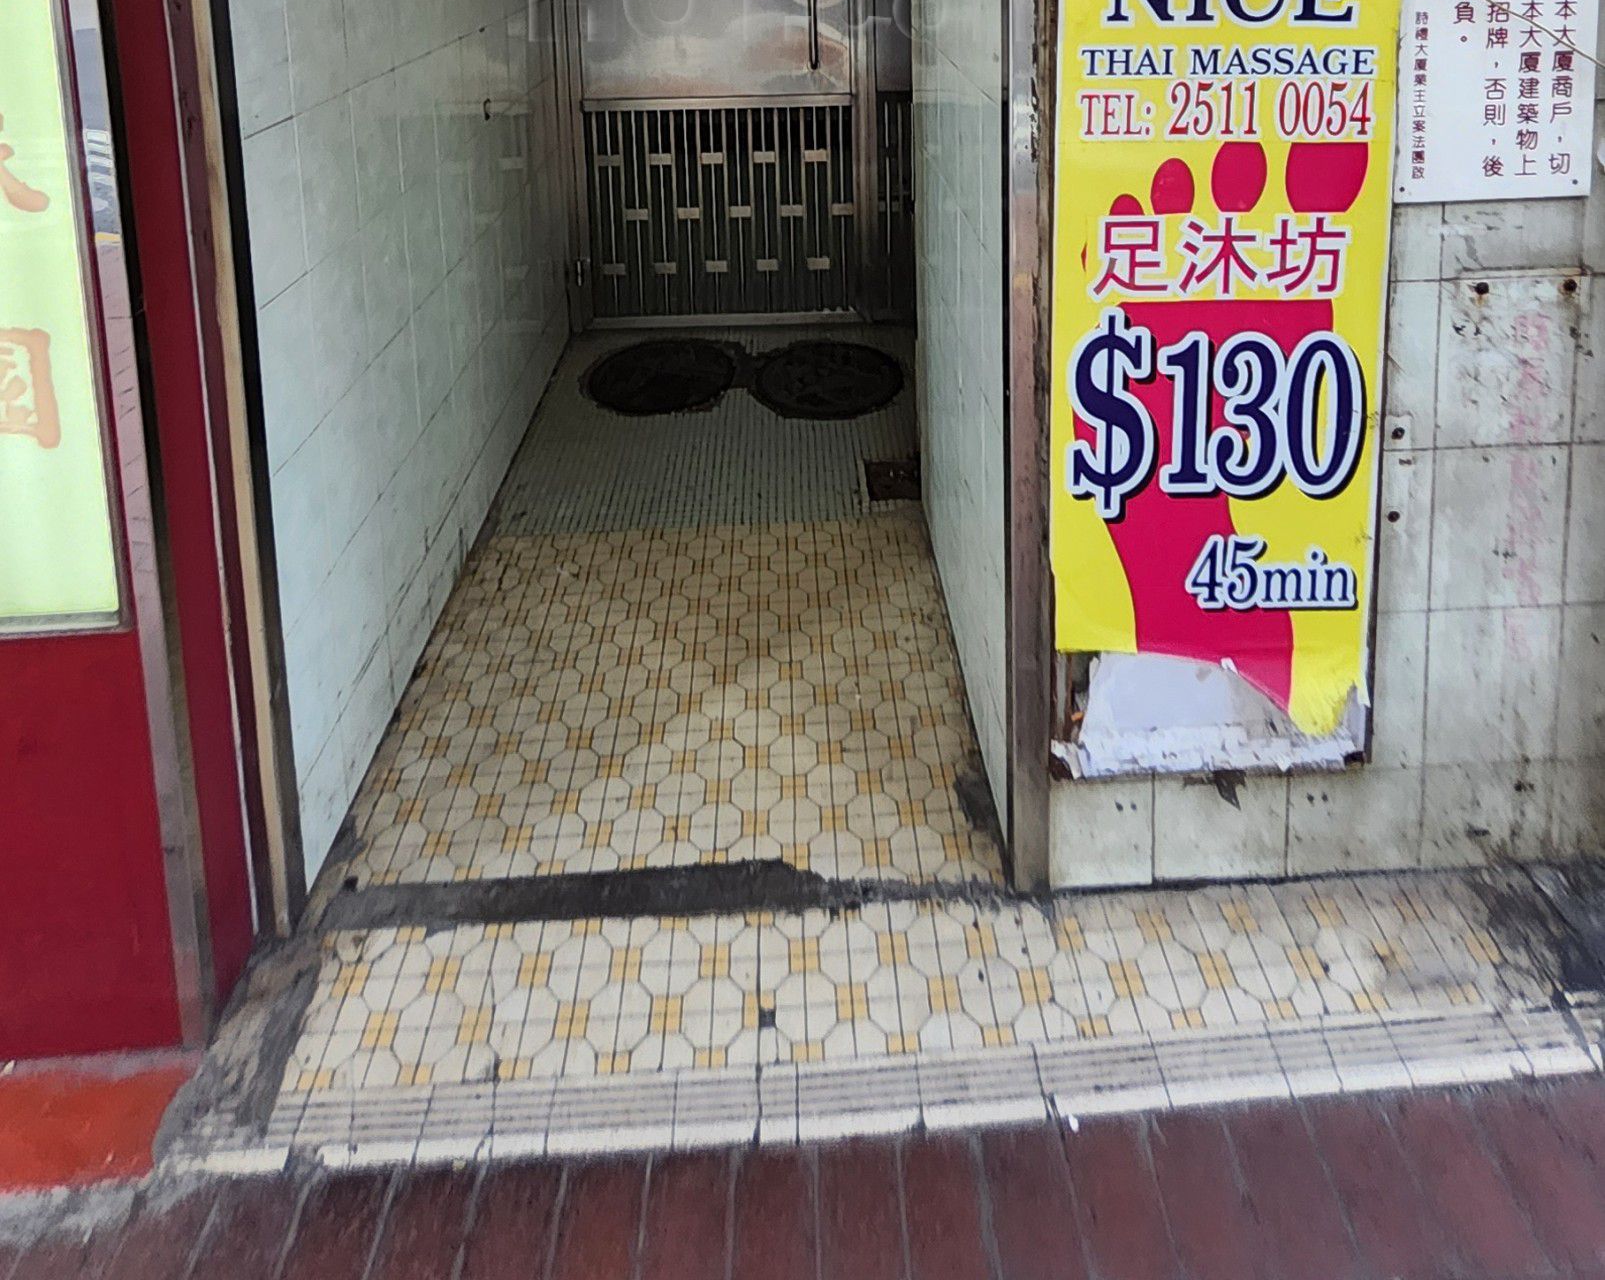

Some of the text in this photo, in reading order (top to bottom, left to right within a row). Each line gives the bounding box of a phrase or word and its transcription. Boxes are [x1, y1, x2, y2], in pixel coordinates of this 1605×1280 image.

[1081, 48, 1374, 76] THAI MASSAGE
[1080, 81, 1371, 136] TEL: 2511 0054
[1092, 217, 1346, 295] 足沐坊
[1072, 314, 1354, 510] $130
[1191, 539, 1352, 604] 45min
